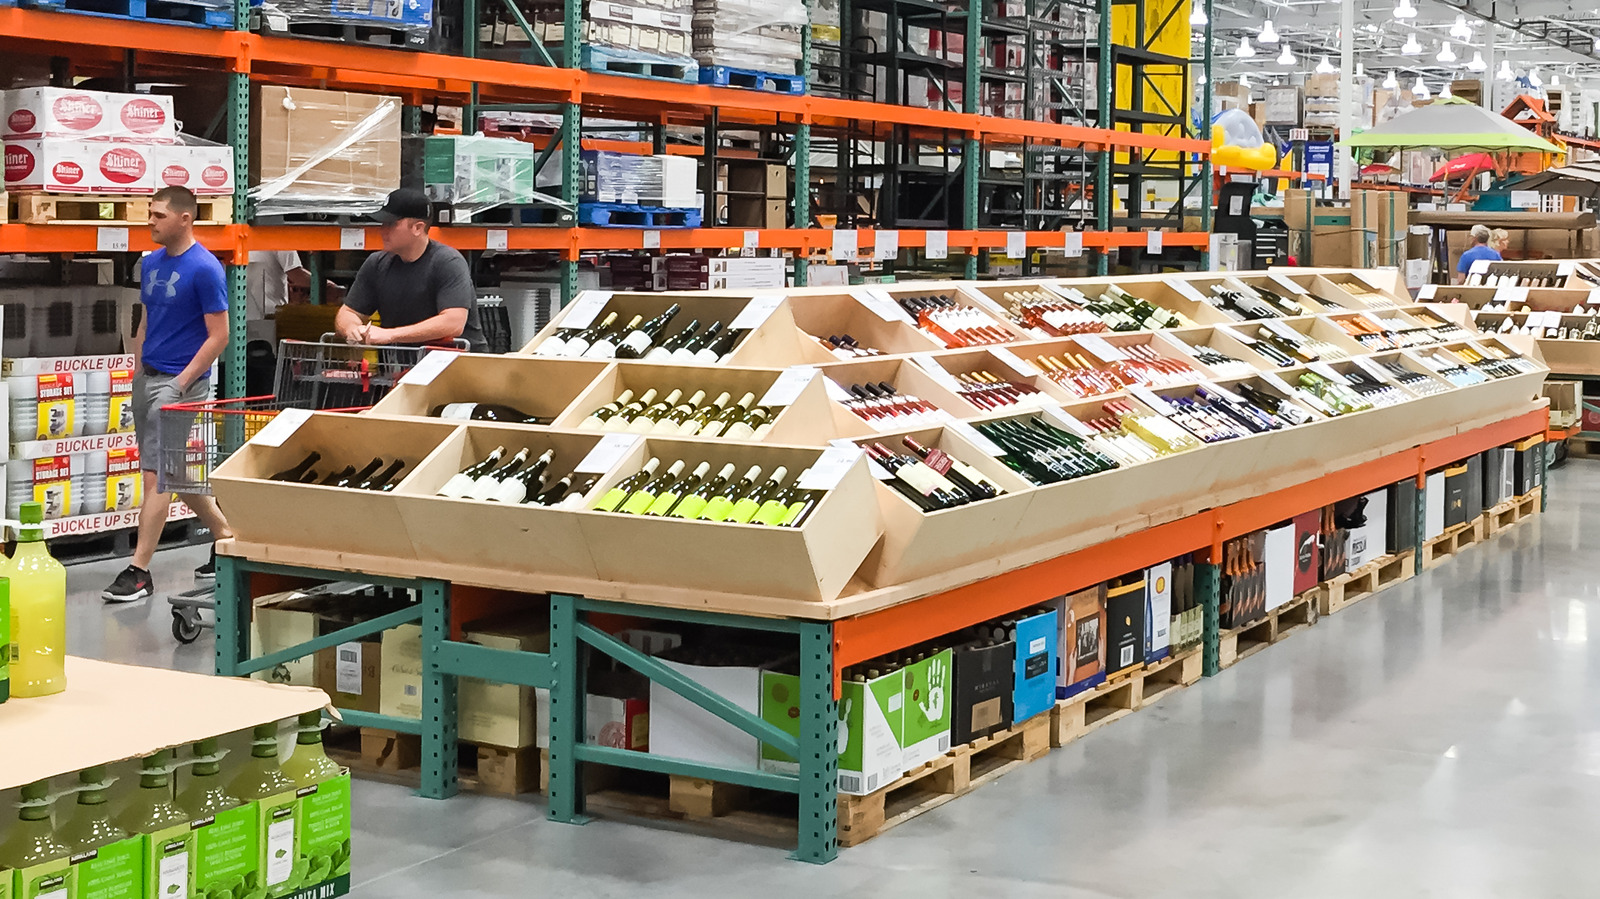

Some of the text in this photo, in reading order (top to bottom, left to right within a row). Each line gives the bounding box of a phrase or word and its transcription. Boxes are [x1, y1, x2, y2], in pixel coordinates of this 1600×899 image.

[127, 104, 161, 119] Shiner
[105, 153, 141, 168] Shiner
[56, 164, 80, 175] Shiner
[54, 358, 104, 372] BUCKLE
[107, 357, 123, 369] UP
[56, 438, 104, 454] BUCKLE
[107, 436, 123, 448] UP
[52, 517, 101, 534] BUCKLE
[104, 514, 121, 527] UP
[320, 883, 335, 899] MIX
